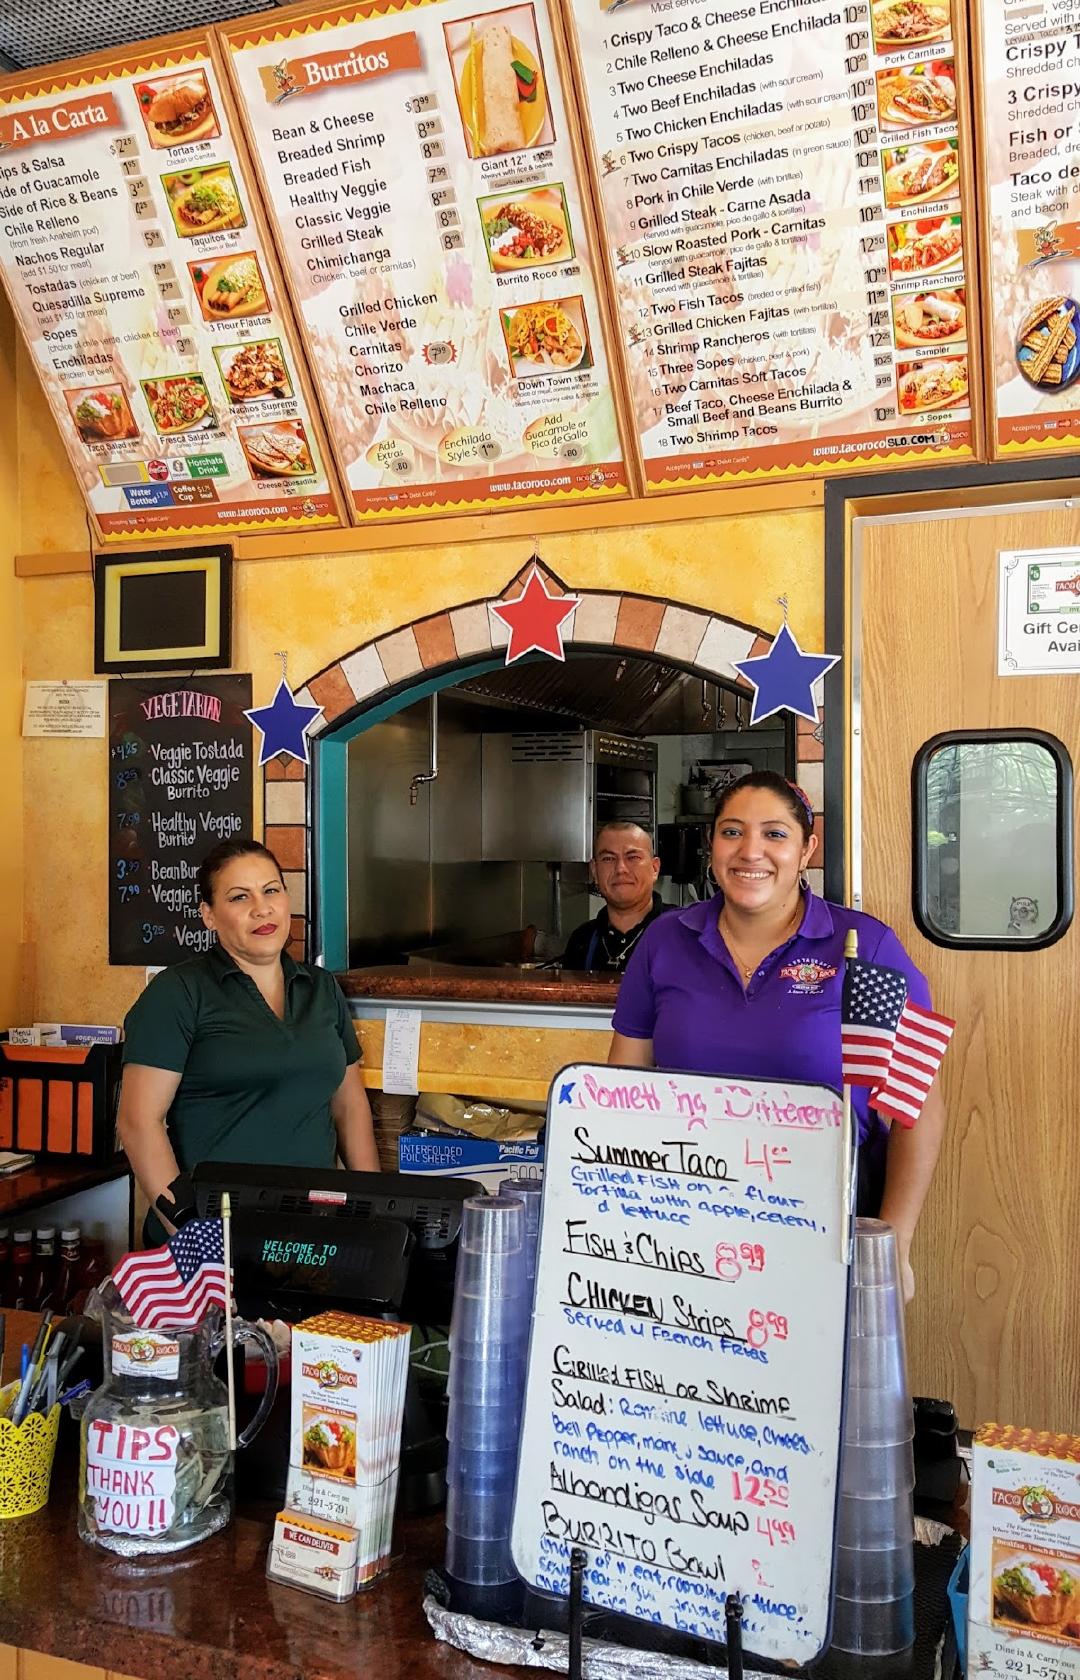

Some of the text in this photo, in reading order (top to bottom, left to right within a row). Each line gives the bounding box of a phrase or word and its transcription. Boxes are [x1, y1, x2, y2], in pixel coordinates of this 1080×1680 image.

[615, 13, 841, 71] Chile Relleno & Cheese Enchilada
[1006, 40, 1066, 62] Crispy
[303, 51, 389, 85] Burritos
[885, 53, 905, 64] Pork
[1006, 62, 1062, 79] Shredded
[617, 52, 773, 97] Two Cheese Enchiladas
[12, 106, 109, 141] A la Carta
[625, 99, 783, 144] Two Chicken Enchiladas
[1008, 104, 1063, 121] Shredded
[272, 110, 374, 141] Bean & Cheese
[881, 129, 931, 144] Grilled Fish
[1009, 125, 1072, 146] Fish or
[278, 132, 385, 164] Breaded Shrimp
[628, 131, 740, 164] Two Crispy Tacos
[34, 169, 99, 192] Guacamole
[284, 158, 371, 186] Breaded Fish
[1010, 170, 1051, 187] Taco
[0, 185, 118, 219] Side of Rice & Beans
[289, 180, 387, 208] Healthy Veggie
[635, 176, 753, 208] Pork in Chile Verde
[1010, 184, 1067, 203] Steak with
[295, 202, 391, 229] Classic Veggie
[639, 206, 717, 230] Grilled Steak
[1011, 200, 1069, 218] and bacon
[301, 225, 384, 250] Grilled Steak
[642, 226, 760, 257] Slow Roasted Pork
[15, 242, 105, 267] Nachos Regular
[307, 249, 391, 271] Chimichanga
[646, 255, 767, 284] Grilled Steak Fajitas
[33, 287, 145, 314] Quesadilla Supreme
[339, 293, 438, 318] Grilled Chicken
[651, 292, 744, 316] Two Fish Tacos
[344, 317, 417, 337] Chile Verde
[654, 306, 789, 336] Grilled Chicken Fajitas
[43, 327, 77, 342] Sopes
[657, 331, 769, 356] Shrimp Rancheros
[53, 352, 113, 369] Enchiladas
[350, 342, 402, 357] Carnitas
[355, 362, 403, 377] Chorizo
[660, 357, 734, 376] Three Sopes
[360, 381, 414, 396] Machaca
[662, 366, 806, 395] Two Carnitas Soft Tacos
[729, 380, 851, 406] Cheese Enchilada &
[230, 400, 297, 415] Nachos Supreme
[364, 397, 447, 416] Chile Relleno
[667, 395, 842, 427] Small Beef and Beans Burrito
[444, 432, 490, 462] Enchilada Style
[188, 457, 223, 469] Horchata
[198, 465, 219, 475] Drink
[130, 488, 151, 498] Water
[490, 476, 570, 492] www.tacoroco.com
[130, 496, 157, 505] Bottled
[1024, 622, 1052, 634] Gift
[140, 690, 222, 722] VEGETARIAN
[151, 739, 243, 769] Veggie Tostada
[152, 765, 239, 790] Classic Veggie
[168, 785, 209, 800] Burrito
[153, 812, 242, 839] Healthy Veggie
[159, 832, 194, 848] Burrito
[152, 884, 192, 911] Veggie
[401, 1144, 538, 1157] INTERFOLDED Pacific Foil
[401, 1153, 419, 1162] FOIL
[576, 1127, 728, 1179] Summer Taco
[688, 1182, 710, 1196] on
[745, 1186, 804, 1208] flour
[262, 1251, 326, 1266] TACO ROCO
[264, 1240, 337, 1256] WELCOME TO
[93, 1419, 176, 1460] TIPS
[88, 1464, 155, 1496] THANK
[609, 1458, 630, 1470] on
[636, 1461, 665, 1479] the
[674, 1465, 714, 1489] side
[993, 1491, 1022, 1505] TACO
